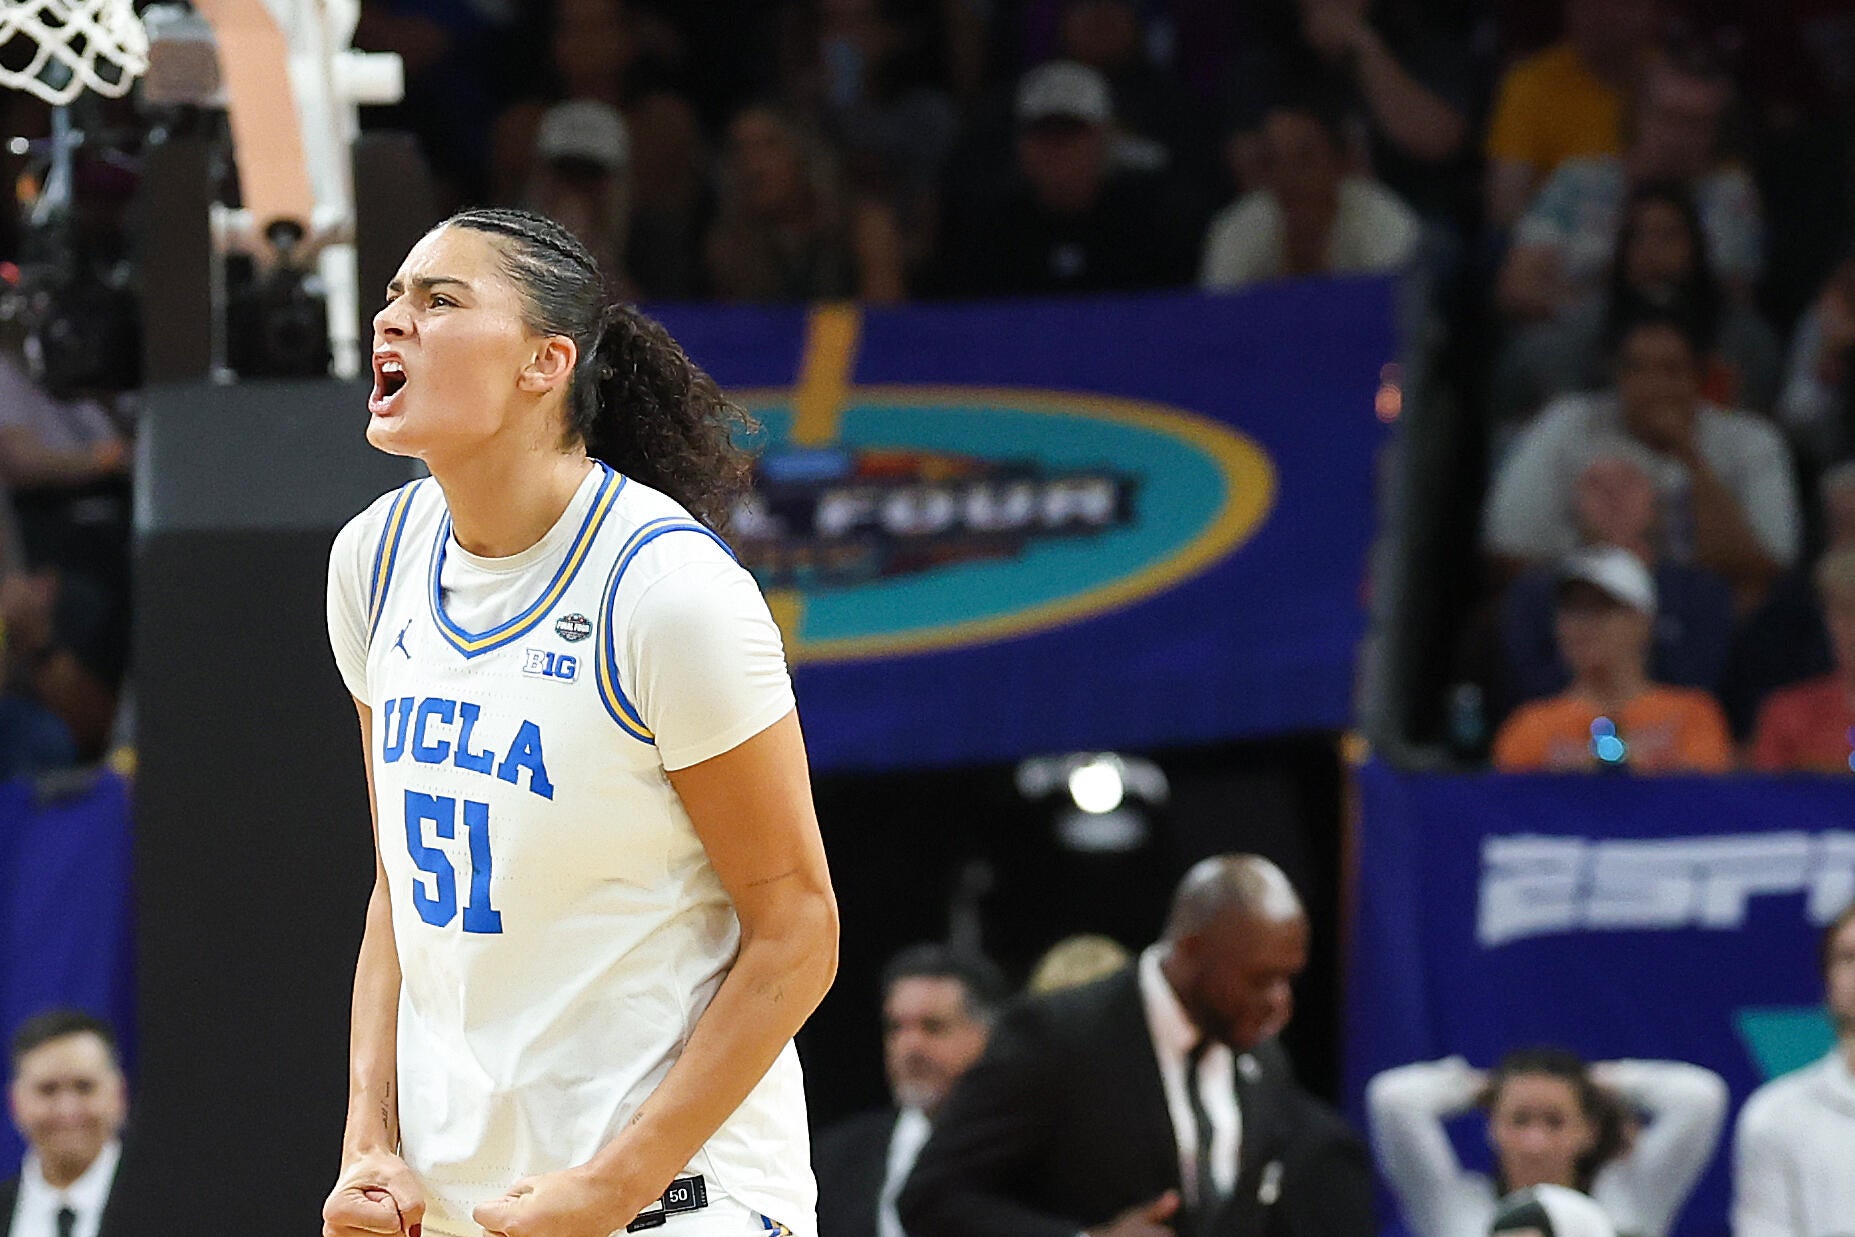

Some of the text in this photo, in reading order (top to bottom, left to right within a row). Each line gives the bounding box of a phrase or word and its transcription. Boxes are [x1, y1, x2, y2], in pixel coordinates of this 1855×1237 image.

[816, 477, 1115, 538] FOUR
[383, 696, 555, 801] UCLA
[404, 788, 504, 934] 51
[669, 1188, 688, 1203] 50
